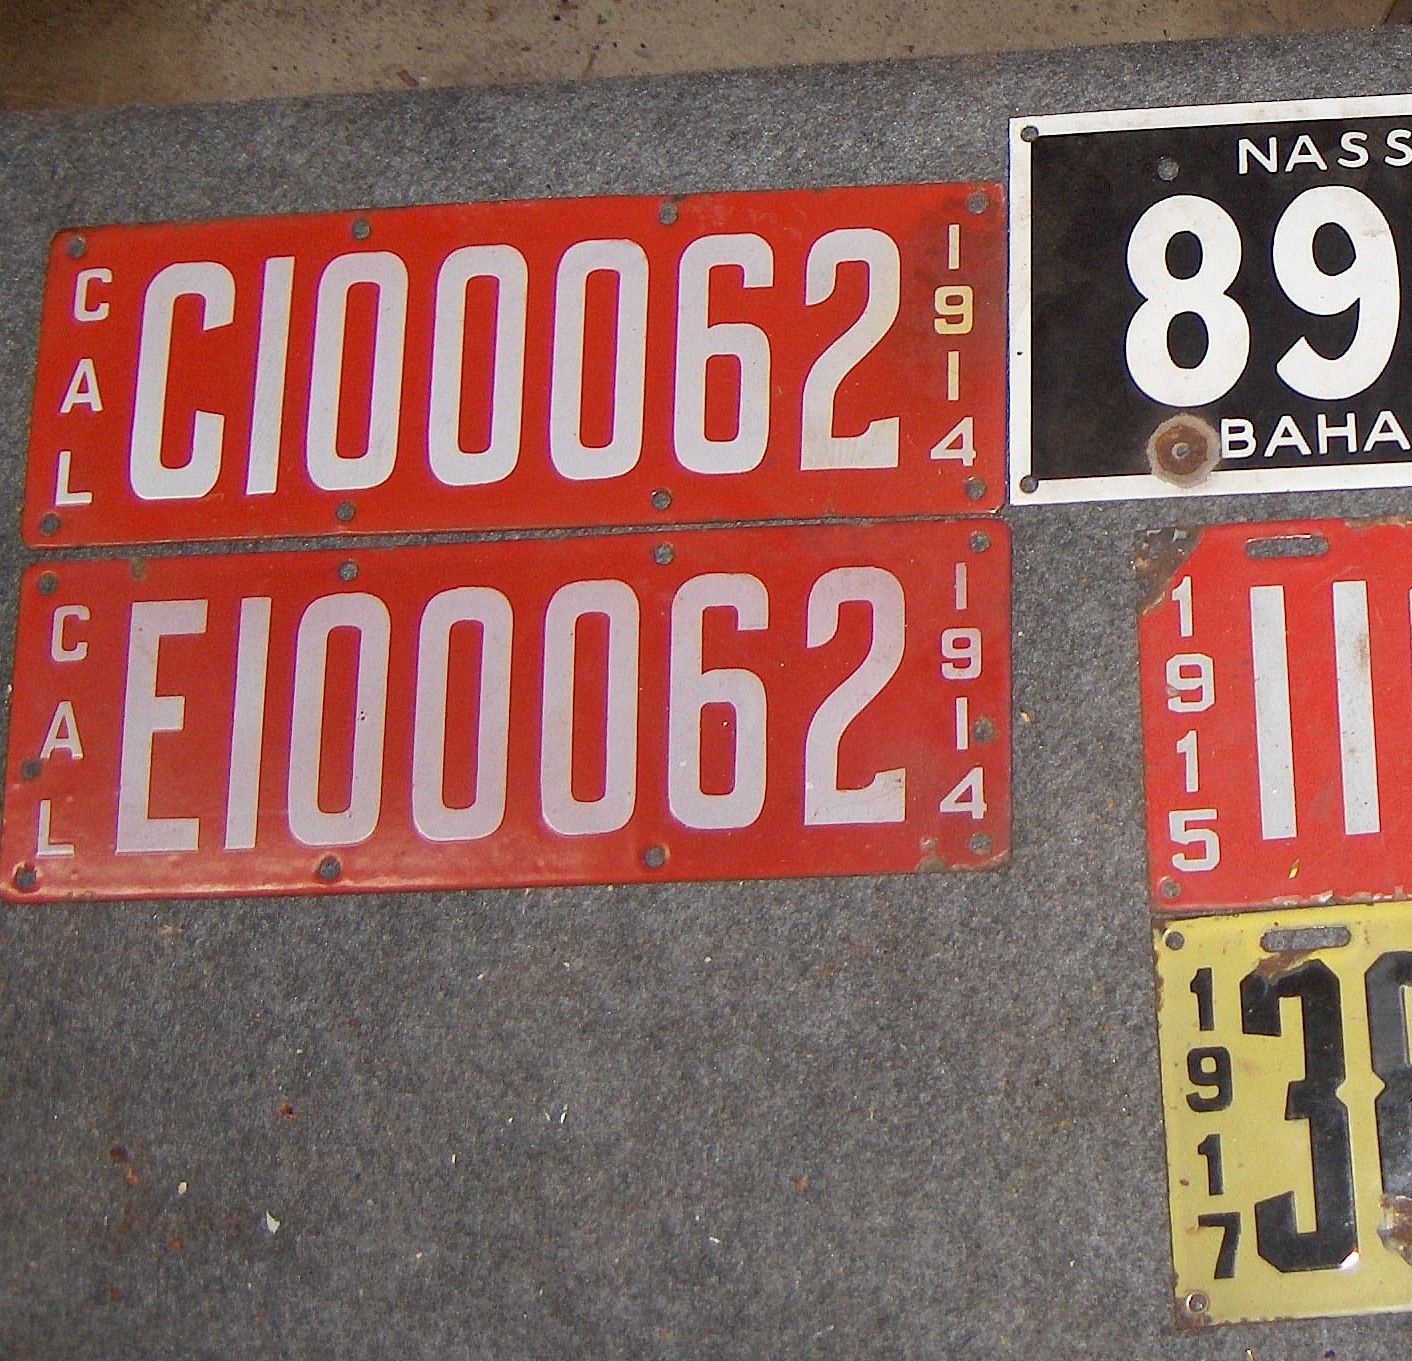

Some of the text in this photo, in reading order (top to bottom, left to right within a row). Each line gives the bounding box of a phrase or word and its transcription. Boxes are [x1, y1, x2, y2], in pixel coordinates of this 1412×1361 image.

[129, 227, 901, 500] C100062
[929, 224, 976, 467] 1914
[115, 565, 906, 855] E100062
[939, 561, 989, 821] 1914
[1165, 576, 1221, 873] 1915
[1187, 967, 1242, 1281] 1917
